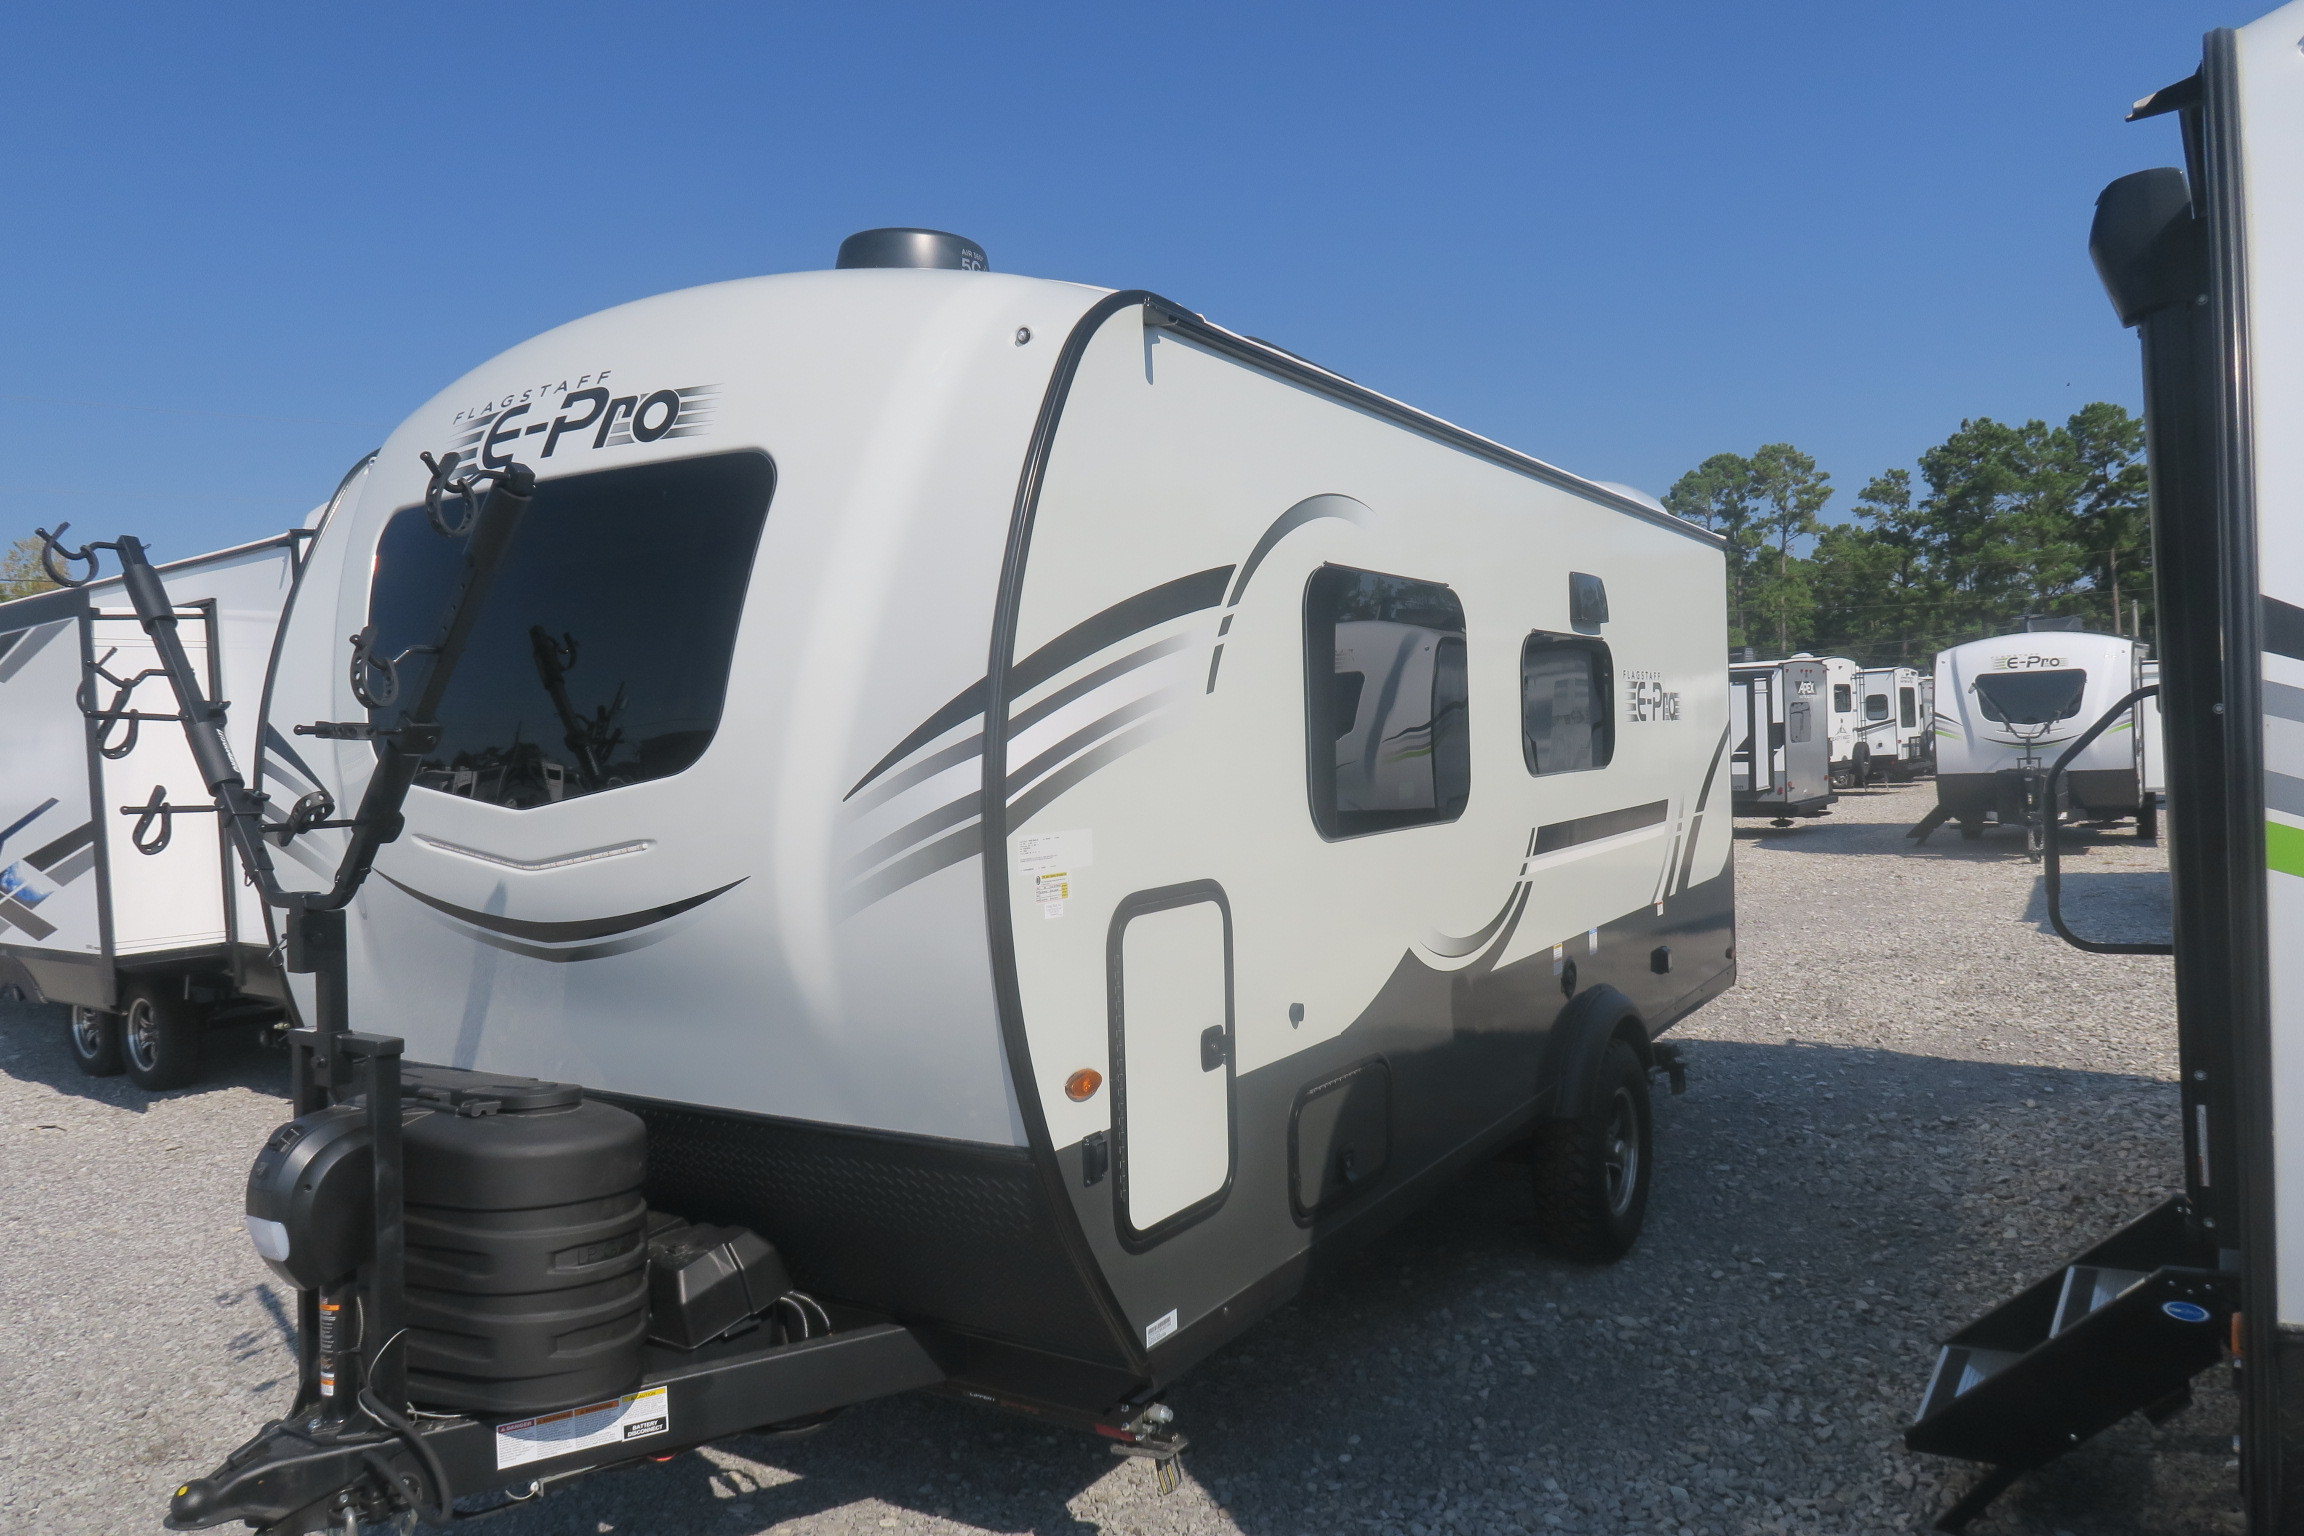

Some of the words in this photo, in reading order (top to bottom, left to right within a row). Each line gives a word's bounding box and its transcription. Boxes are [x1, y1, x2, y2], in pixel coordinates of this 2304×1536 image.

[453, 370, 611, 425] FLAGSTAFF
[481, 385, 681, 470] E-Pro
[2007, 655, 2060, 669] E-Pro
[1622, 669, 1661, 680] FLAGSTAFF
[1797, 680, 1815, 695] APEX
[1637, 681, 1676, 722] E-Pro
[506, 1420, 533, 1431] DANGER
[627, 1423, 664, 1438] DISCONNECT
[632, 1420, 659, 1431] BATTERY
